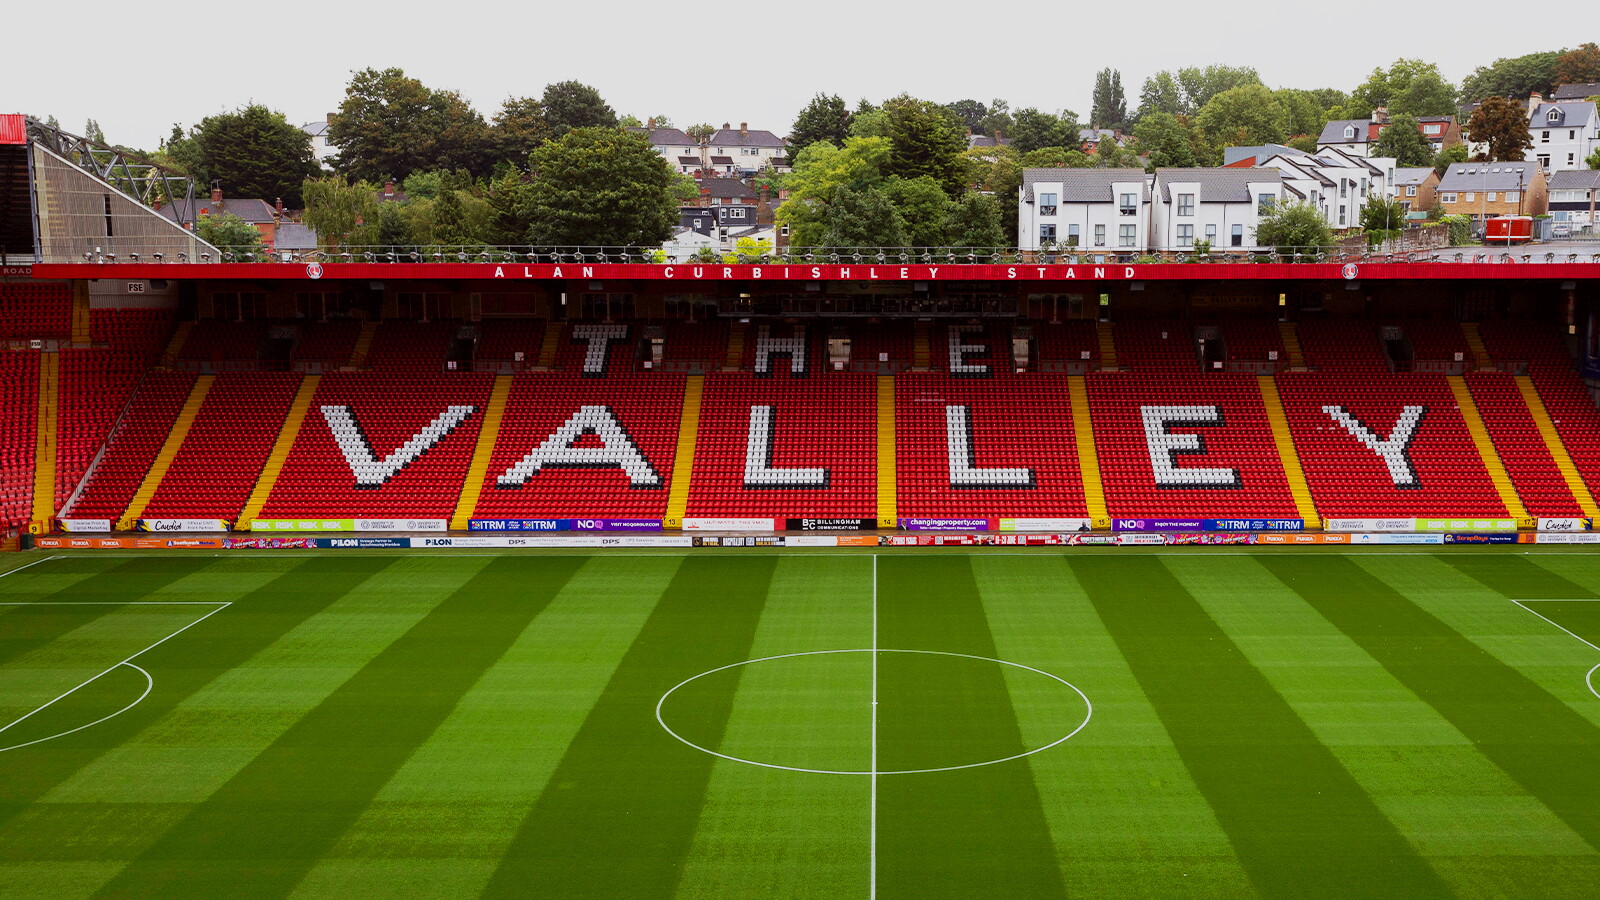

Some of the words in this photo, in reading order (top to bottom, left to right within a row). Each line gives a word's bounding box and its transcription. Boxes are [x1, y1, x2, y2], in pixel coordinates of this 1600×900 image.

[3, 267, 32, 275] ROAD
[494, 267, 593, 278] ALAN
[664, 267, 938, 278] CURBISHLEY
[1007, 267, 1135, 278] STAND
[128, 283, 144, 292] FSE
[572, 325, 988, 375] THE
[320, 405, 1424, 486] VALLEY
[155, 520, 182, 530] Candid
[252, 521, 271, 529] RSK
[275, 521, 294, 529] RSK
[298, 521, 318, 529] RSK
[322, 521, 342, 529] RSK
[480, 520, 505, 529] ITRM
[531, 521, 556, 529] ITRM
[910, 518, 986, 526] changingproperty.com
[1225, 521, 1249, 529] ITRM
[1275, 521, 1300, 529] ITRM
[1427, 521, 1446, 529] RSK
[1450, 521, 1469, 529] RSK
[1473, 521, 1492, 529] RSK
[1496, 521, 1516, 529] RSK
